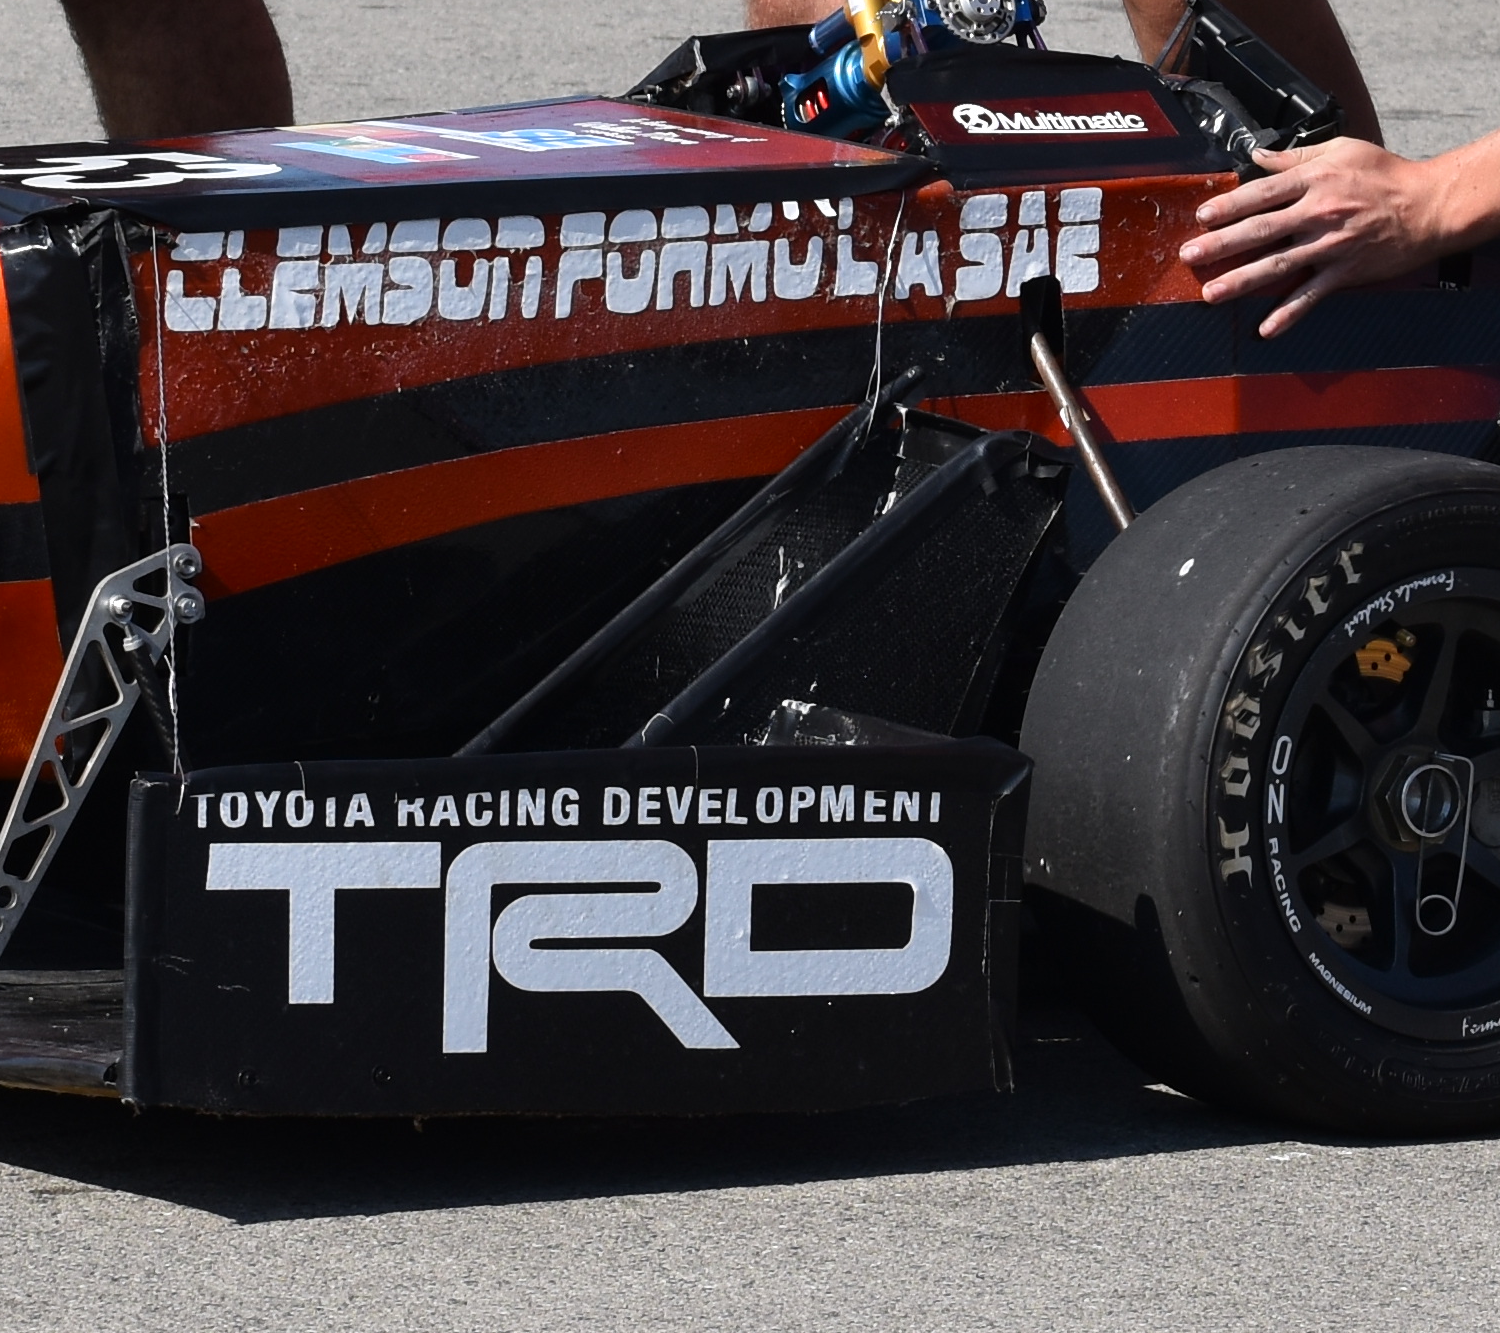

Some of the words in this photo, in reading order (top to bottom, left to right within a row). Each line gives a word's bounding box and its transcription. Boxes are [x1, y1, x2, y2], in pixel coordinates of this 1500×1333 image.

[998, 108, 1147, 132] Multimatic
[164, 215, 547, 332] CLEMSON
[554, 196, 944, 321] FORMULA
[954, 186, 1104, 302] SAE
[1342, 591, 1399, 637] Student
[1395, 569, 1457, 605] Formula
[189, 790, 377, 830] TOYOTA
[393, 787, 580, 829] RACING
[602, 783, 942, 826] DEVELOPMENT
[1267, 835, 1302, 934] RACING
[204, 836, 955, 1054] TRD
[1307, 950, 1373, 1015] MAGNESIUM
